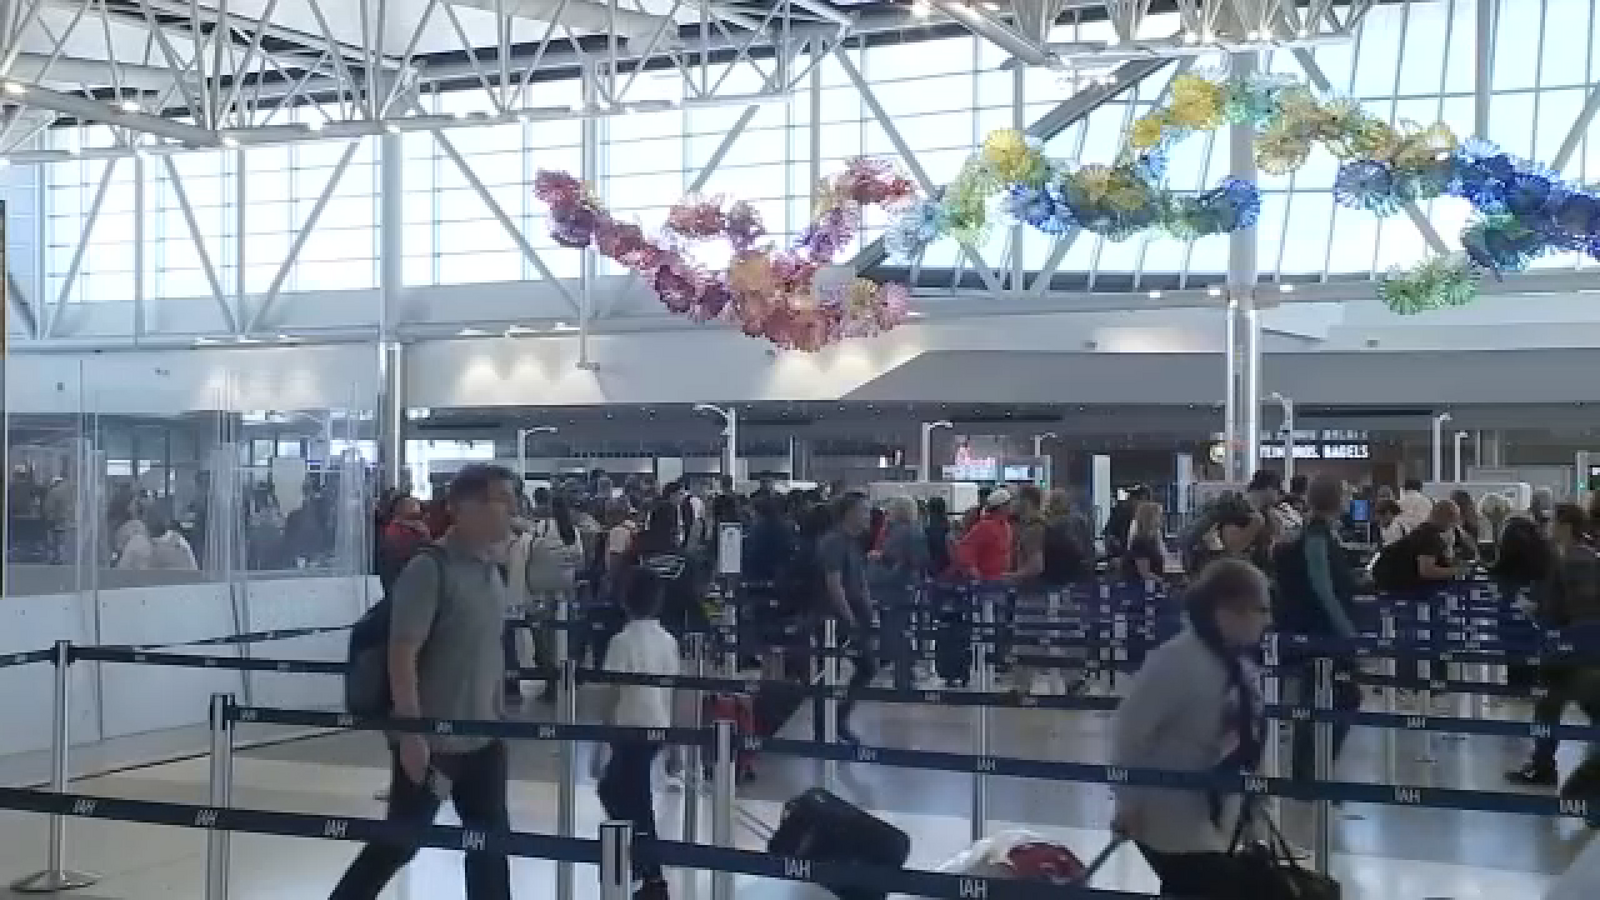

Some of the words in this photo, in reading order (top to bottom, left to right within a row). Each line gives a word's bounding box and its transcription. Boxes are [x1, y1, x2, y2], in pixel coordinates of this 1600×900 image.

[1324, 444, 1369, 458] BAGELS
[1395, 786, 1420, 803] IAH
[1559, 799, 1585, 815] IAH
[195, 809, 218, 825] IAH
[325, 819, 348, 838] IAH
[462, 830, 486, 850] IAH
[785, 857, 811, 878] IAH
[959, 879, 986, 898] IAH
